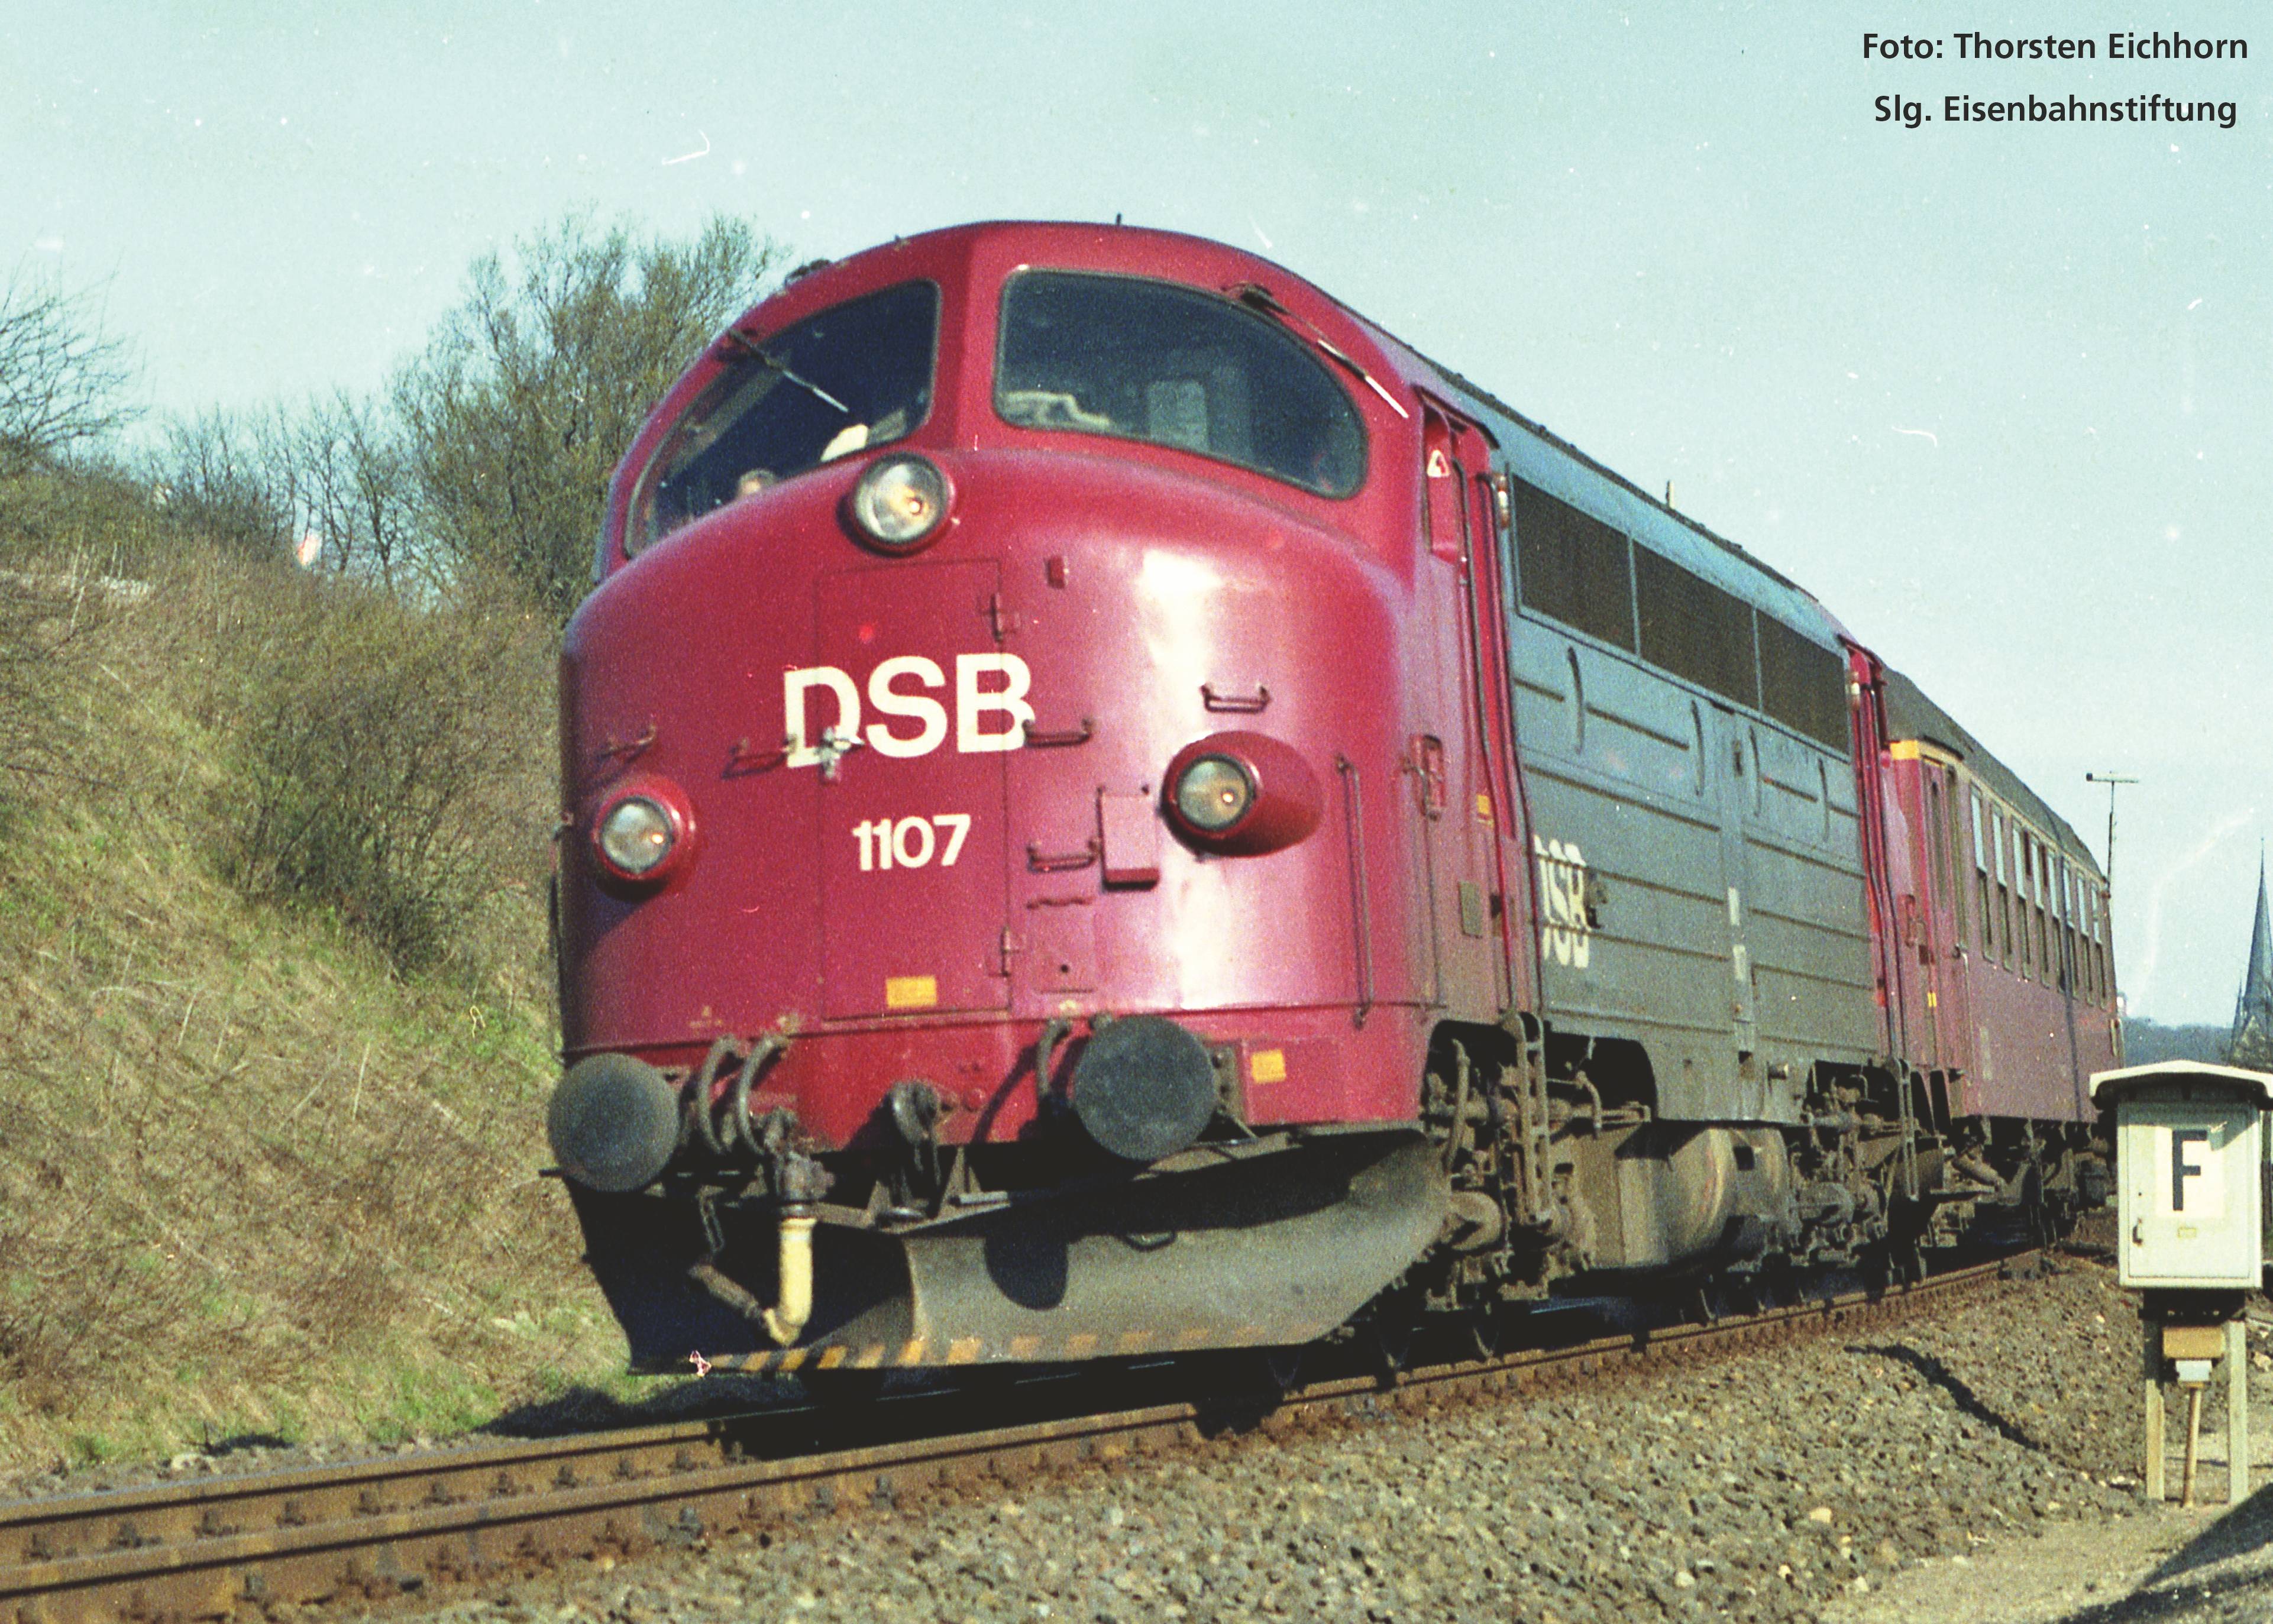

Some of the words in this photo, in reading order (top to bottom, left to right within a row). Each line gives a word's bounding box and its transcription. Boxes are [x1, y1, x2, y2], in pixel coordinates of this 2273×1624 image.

[784, 652, 1036, 768] DSB
[852, 814, 971, 871] 1107
[2172, 1130, 2207, 1211] F
